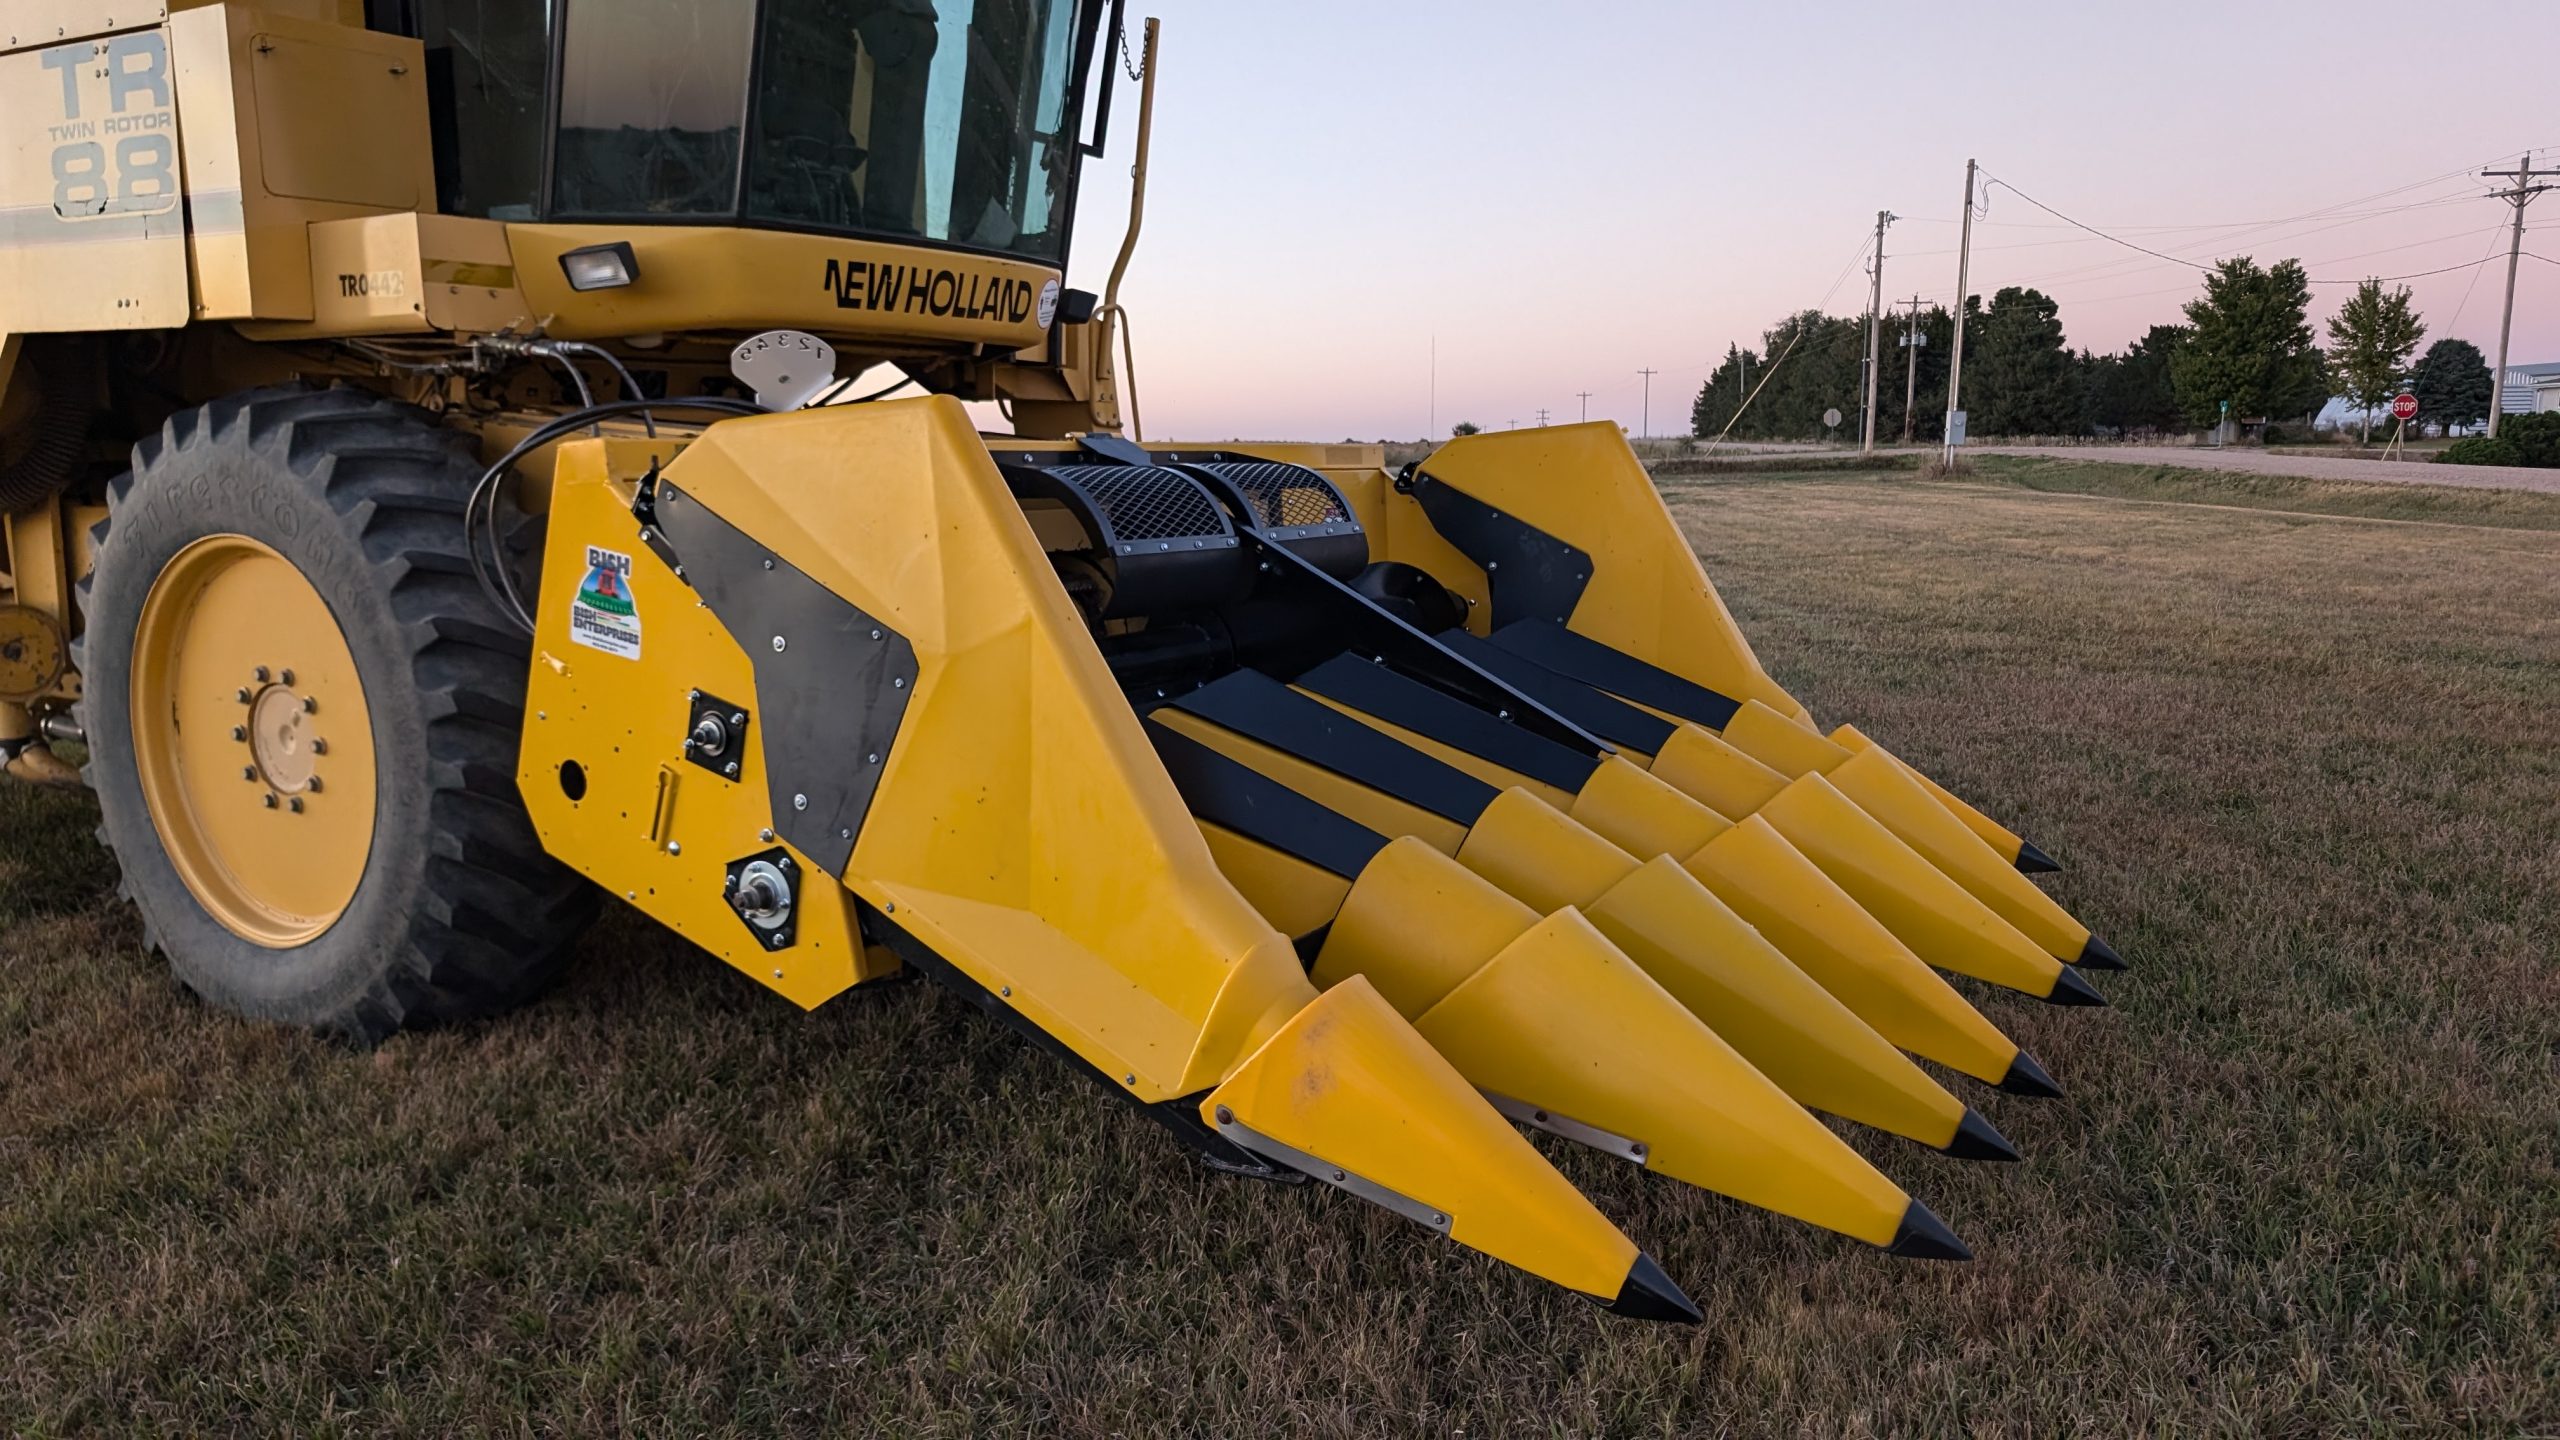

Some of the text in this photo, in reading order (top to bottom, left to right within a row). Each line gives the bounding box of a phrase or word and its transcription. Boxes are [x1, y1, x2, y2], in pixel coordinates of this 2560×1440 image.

[41, 32, 170, 120] TR
[49, 112, 172, 142] TWIN ROTOR
[51, 134, 175, 216] 88
[824, 259, 1032, 323] NEW HOLLAND
[2394, 402, 2416, 412] STOP
[589, 548, 630, 577] BISH
[573, 605, 597, 622] BISH
[573, 616, 639, 645] ENTERPRISES
